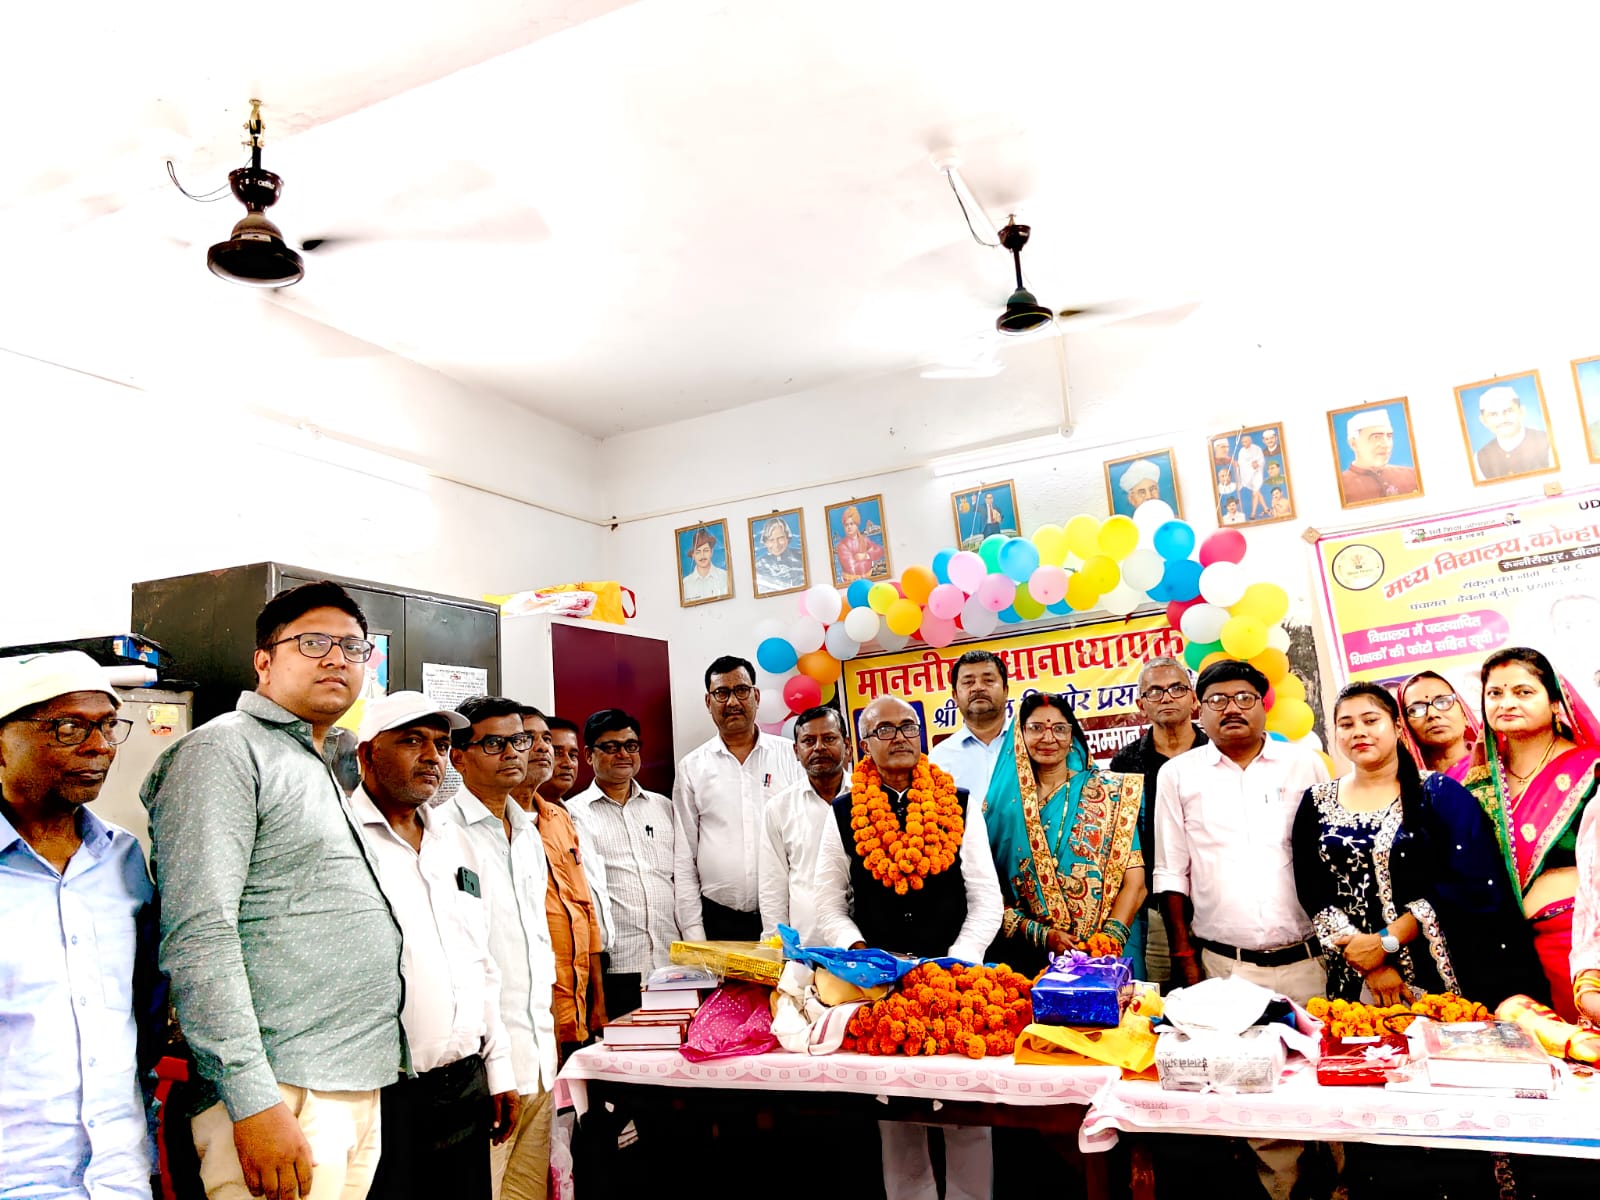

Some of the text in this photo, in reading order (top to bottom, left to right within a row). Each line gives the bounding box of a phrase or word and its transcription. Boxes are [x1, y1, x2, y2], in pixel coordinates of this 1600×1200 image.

[1384, 565, 1430, 599] मध्य
[1367, 628, 1410, 645] विद्यालय
[1412, 621, 1424, 637] में
[1388, 644, 1406, 658] की
[1407, 639, 1433, 655] फोटो
[1435, 635, 1467, 651] सहित
[1000, 627, 1185, 681] धानाध्यापक
[933, 698, 958, 728] श्री
